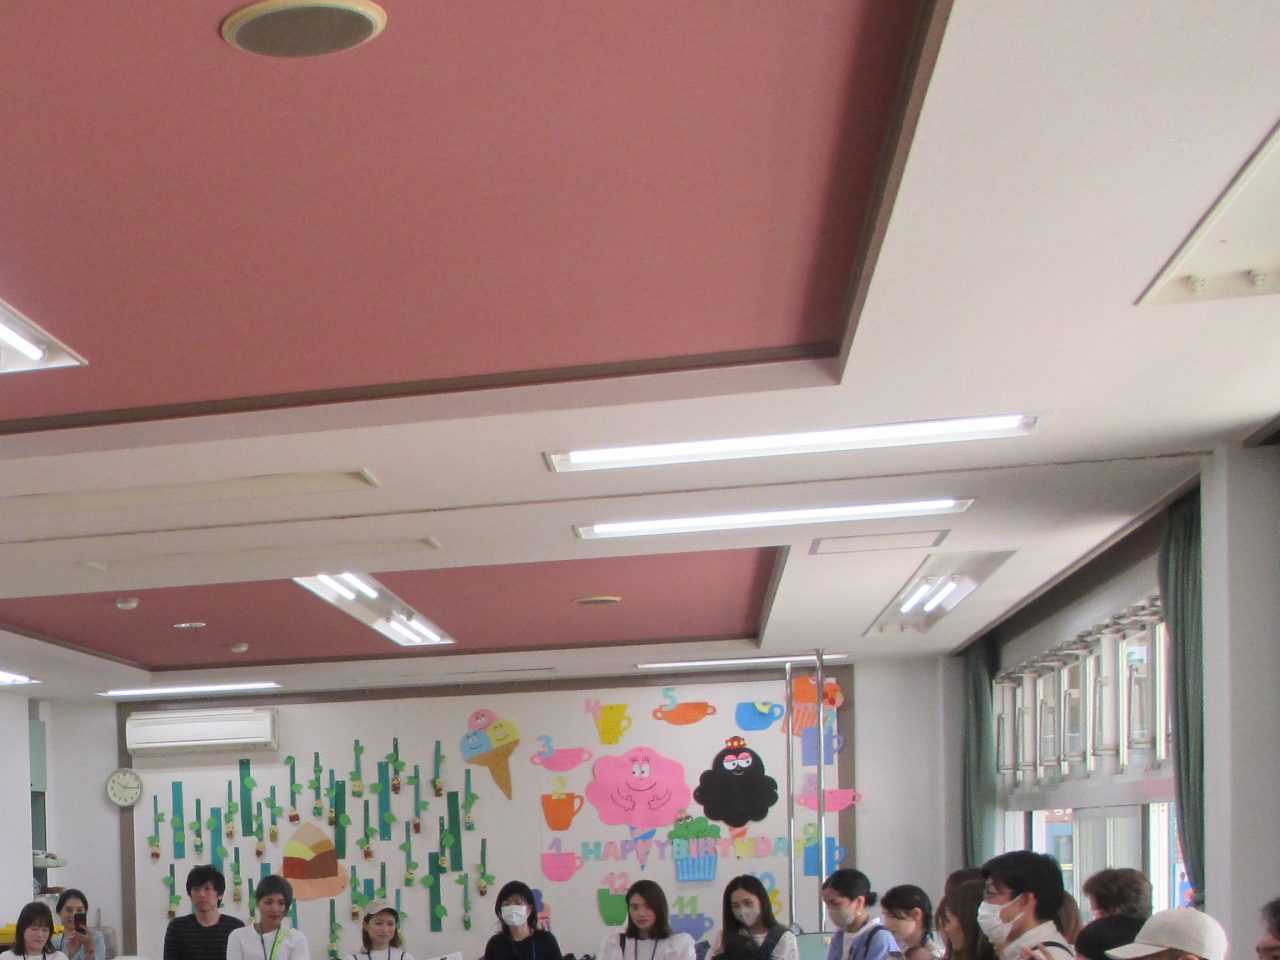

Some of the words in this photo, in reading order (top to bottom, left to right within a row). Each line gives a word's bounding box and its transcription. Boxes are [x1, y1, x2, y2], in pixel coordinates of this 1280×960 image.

[663, 687, 677, 711] 5
[537, 735, 555, 758] 3
[549, 837, 562, 860] 1
[581, 839, 669, 861] HAPPY
[602, 872, 631, 895] 12
[673, 896, 698, 919] 11
